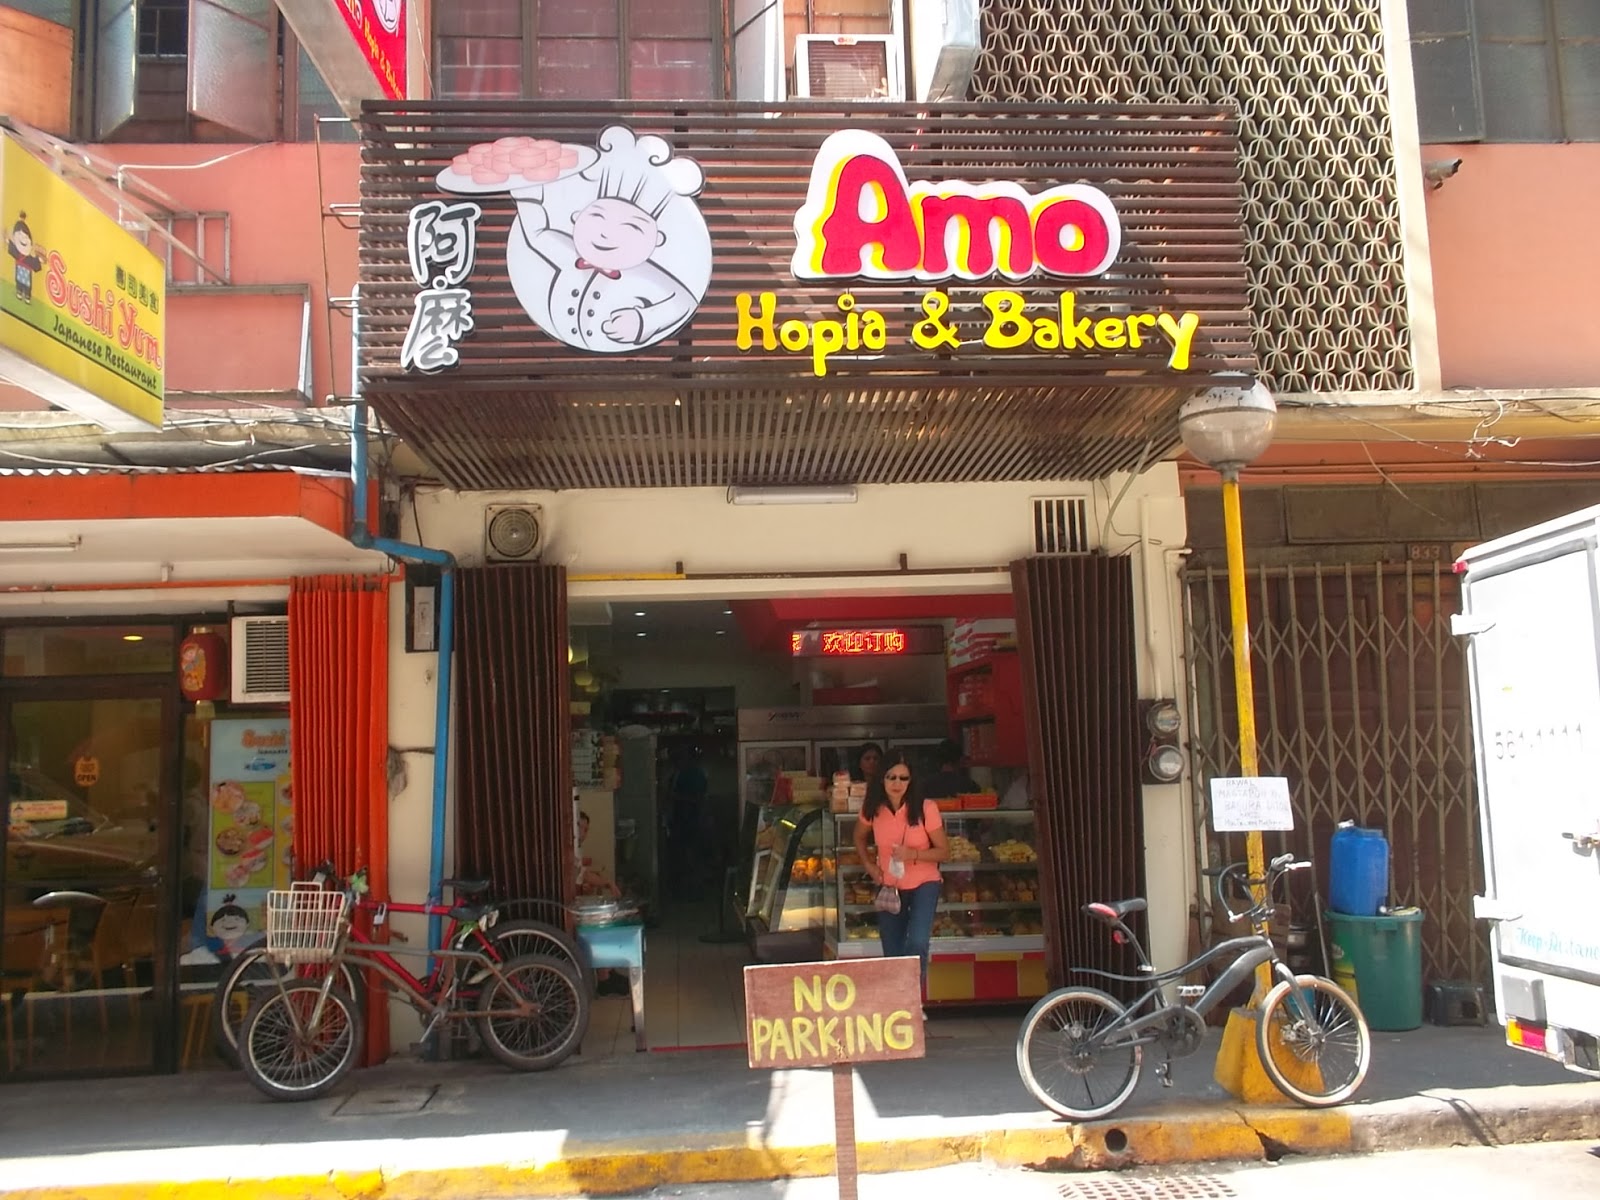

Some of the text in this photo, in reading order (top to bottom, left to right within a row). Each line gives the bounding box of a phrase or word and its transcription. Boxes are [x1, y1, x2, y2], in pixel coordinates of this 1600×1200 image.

[803, 145, 1114, 278] Amo
[46, 250, 163, 371] Sushi Yum
[735, 290, 1200, 378] Hopia & Bakery
[53, 314, 158, 390] Japanese Restaurant
[823, 630, 905, 653] 欢迎订购
[77, 774, 97, 782] OPEN
[793, 974, 857, 1013] NO
[752, 1010, 914, 1062] PARKING
